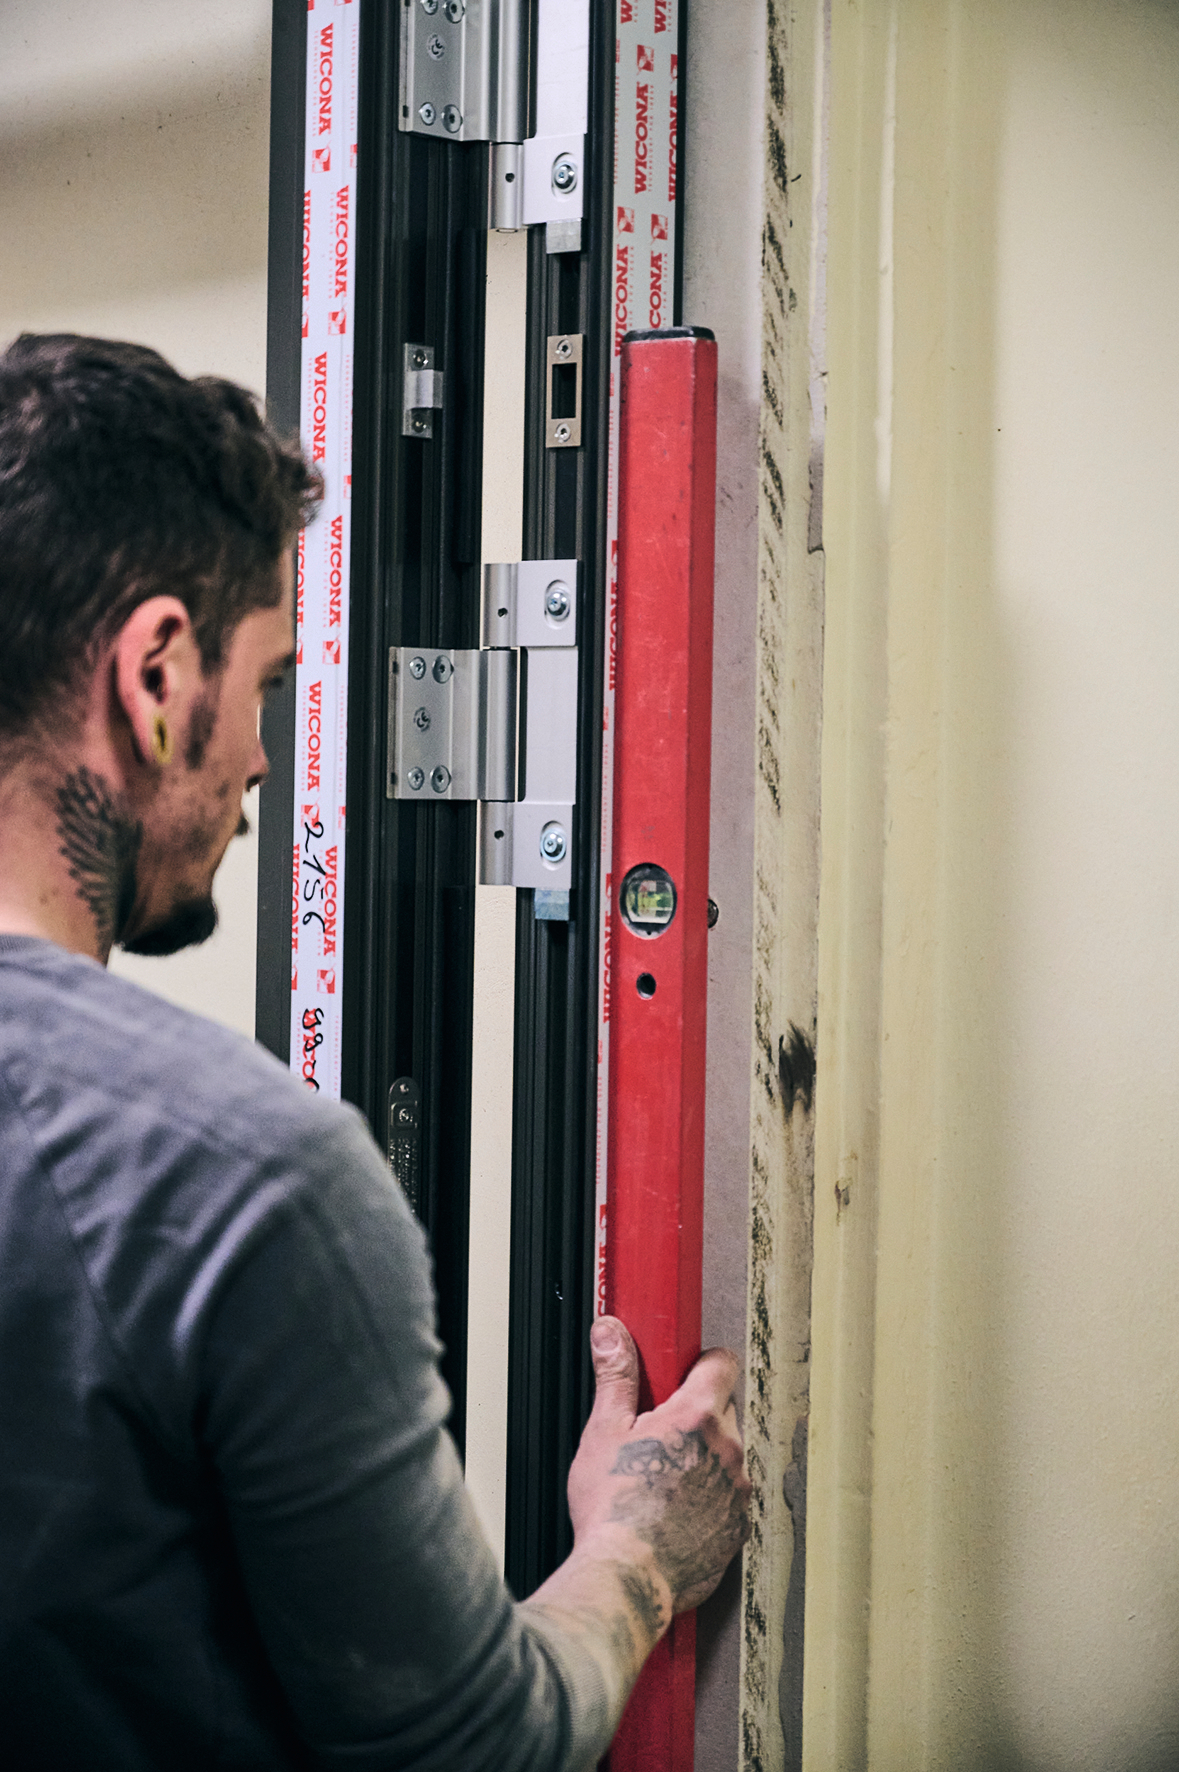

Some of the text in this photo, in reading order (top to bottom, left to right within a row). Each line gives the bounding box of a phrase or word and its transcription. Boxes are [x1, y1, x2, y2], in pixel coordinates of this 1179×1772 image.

[319, 22, 334, 136] WICONA
[634, 81, 649, 194] WICONA
[335, 185, 349, 298] WICONA
[650, 250, 662, 329] CONA
[312, 351, 327, 464] WICONA
[329, 515, 343, 628] WICONA
[307, 680, 322, 792] WICONA
[302, 821, 327, 934] 2156
[323, 845, 338, 957] WICONA
